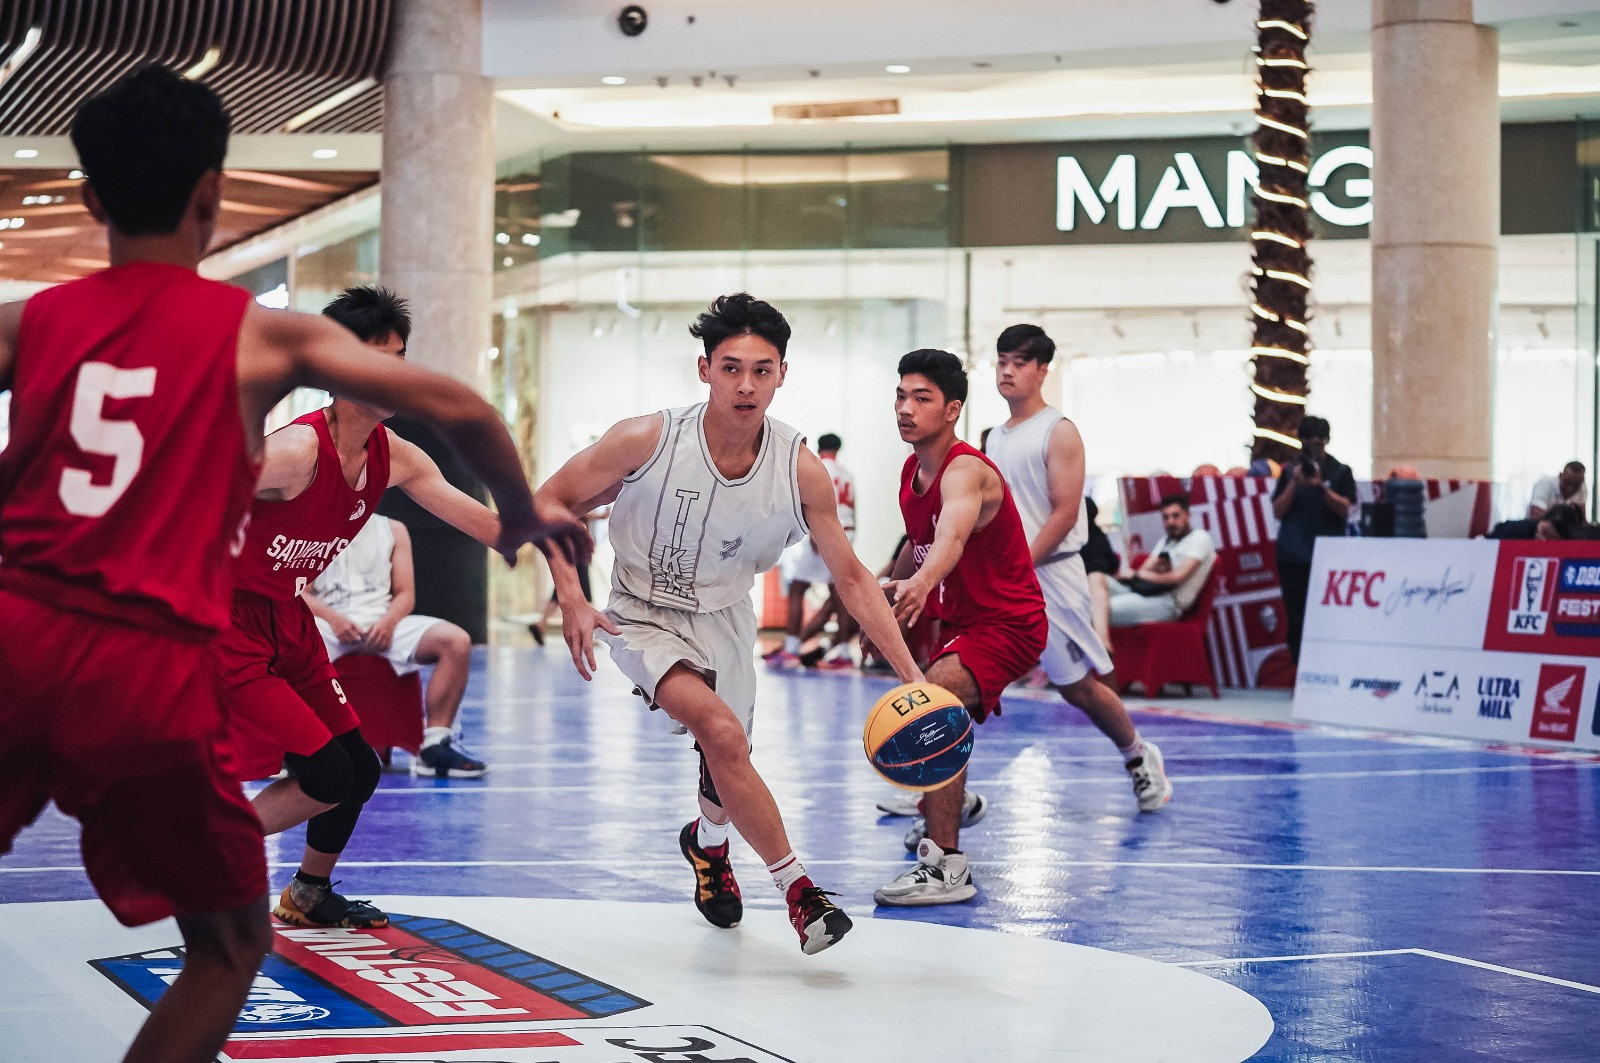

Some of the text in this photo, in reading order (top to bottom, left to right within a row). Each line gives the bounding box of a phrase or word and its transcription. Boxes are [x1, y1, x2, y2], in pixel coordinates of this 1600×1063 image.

[58, 361, 157, 518] 5
[1321, 570, 1386, 608] KFC
[1514, 614, 1542, 630] KFC
[331, 678, 347, 704] 9
[1477, 676, 1520, 699] ULTRA
[1478, 698, 1514, 720] MILK
[271, 923, 531, 1018] FESTIVA
